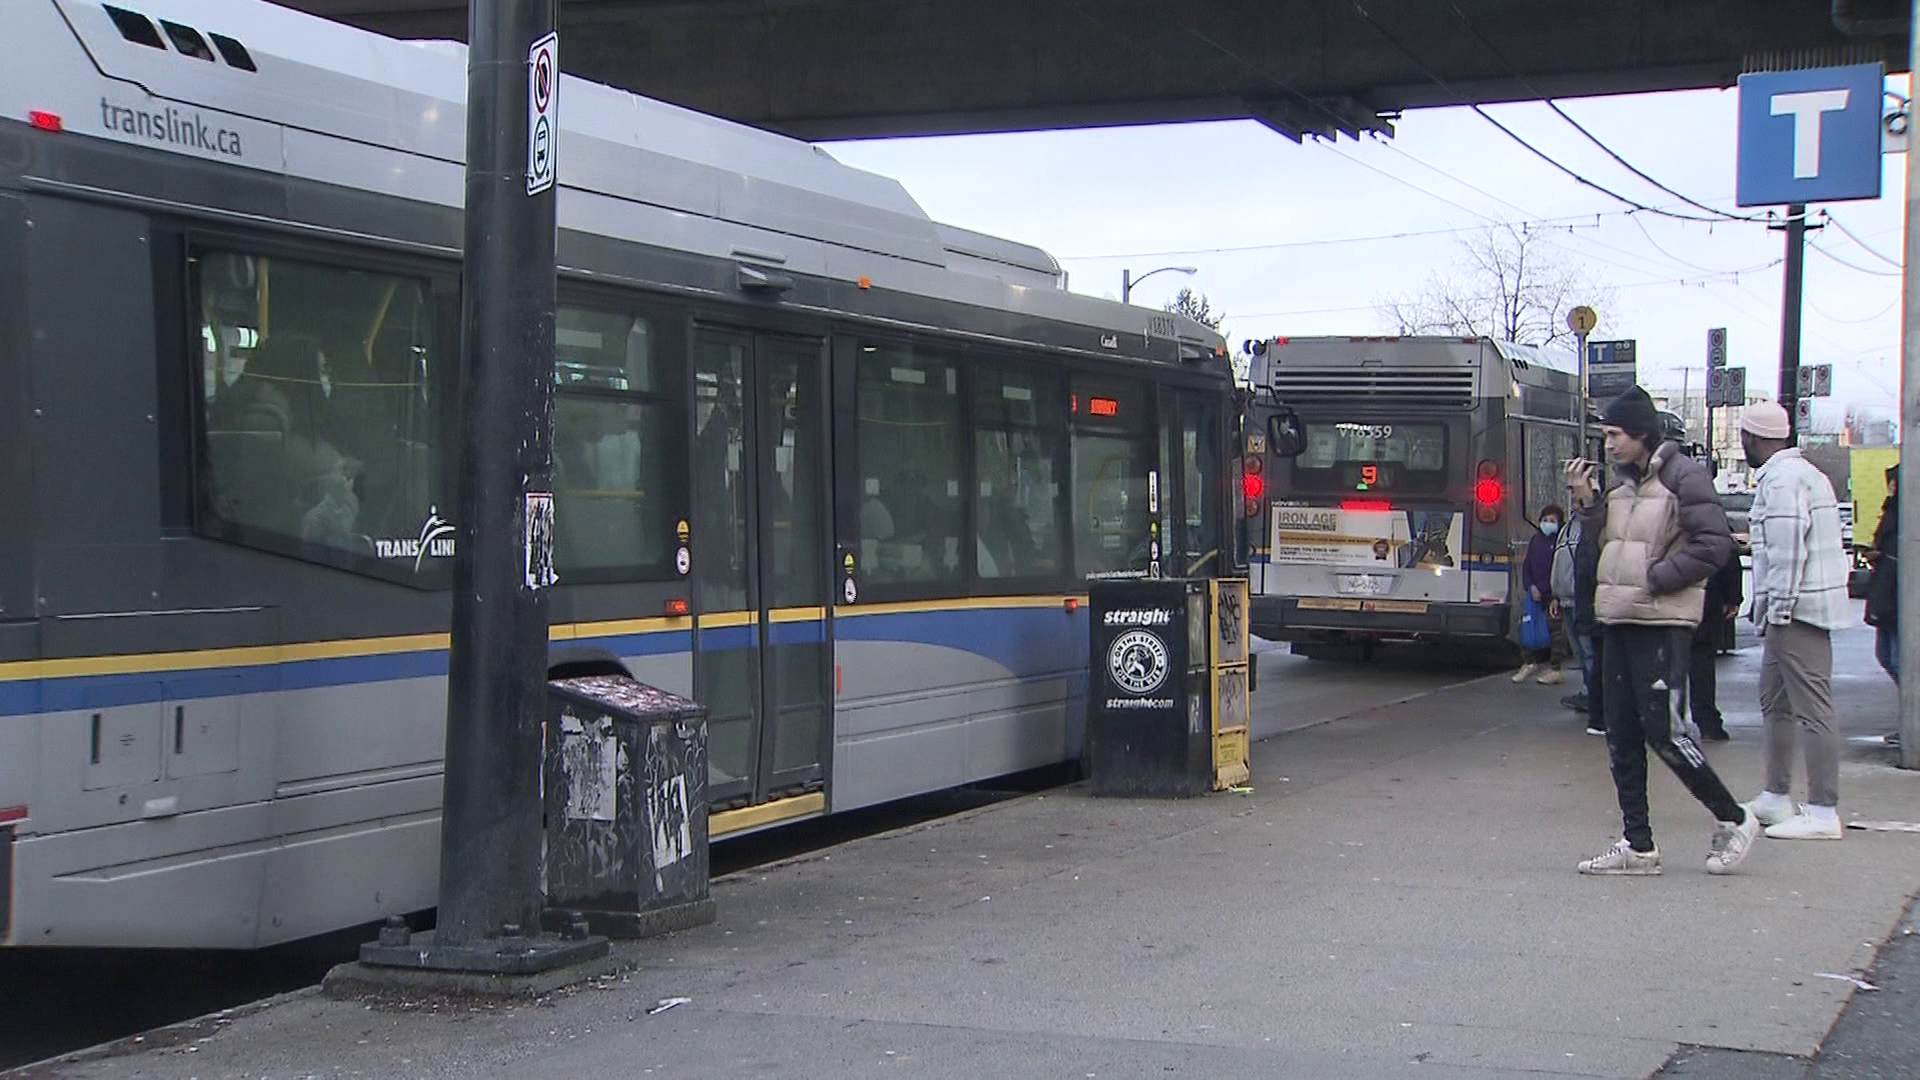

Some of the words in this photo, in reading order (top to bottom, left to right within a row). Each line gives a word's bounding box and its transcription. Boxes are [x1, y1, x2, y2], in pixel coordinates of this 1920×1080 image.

[101, 97, 242, 156] translink.ca
[1769, 88, 1850, 179] T
[1593, 344, 1607, 361] T
[1362, 465, 1377, 484] 9
[1279, 511, 1308, 524] IRON
[1311, 513, 1336, 525] AGE
[376, 539, 419, 558] TRANS
[1103, 608, 1170, 626] straight
